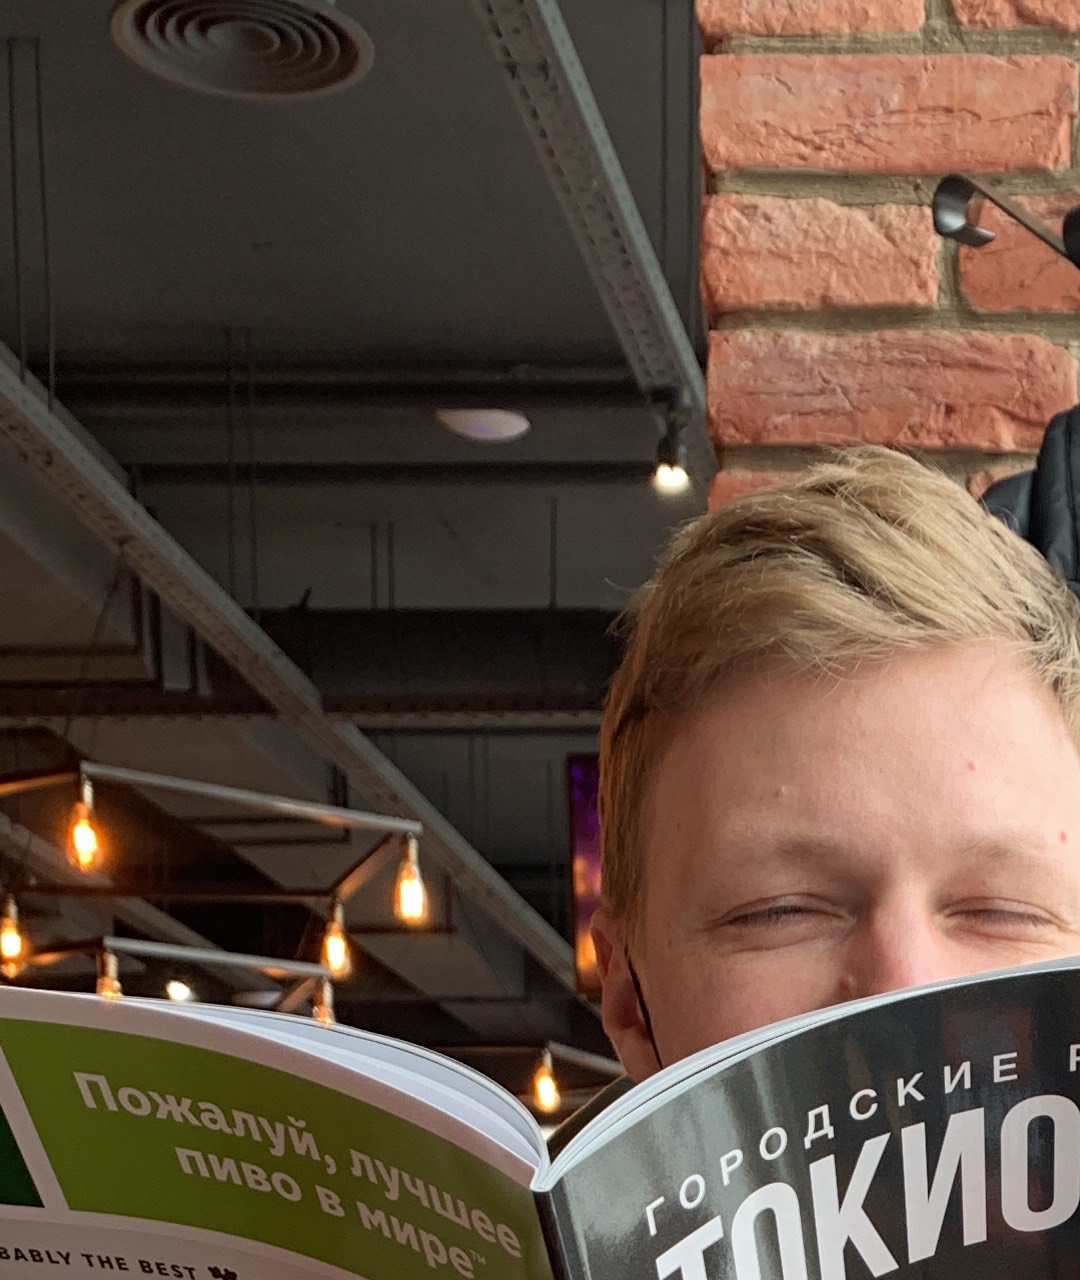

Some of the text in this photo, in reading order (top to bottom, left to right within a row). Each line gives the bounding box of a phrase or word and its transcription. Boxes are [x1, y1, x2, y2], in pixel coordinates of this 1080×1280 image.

[73, 1071, 522, 1257] Пожалуй, лучшее
[175, 1146, 301, 1201] пиво
[316, 1185, 345, 1218] в
[645, 1052, 1018, 1237] ГОРОДСКИЕ
[81, 1253, 129, 1271] THE
[138, 1259, 196, 1280] BEST
